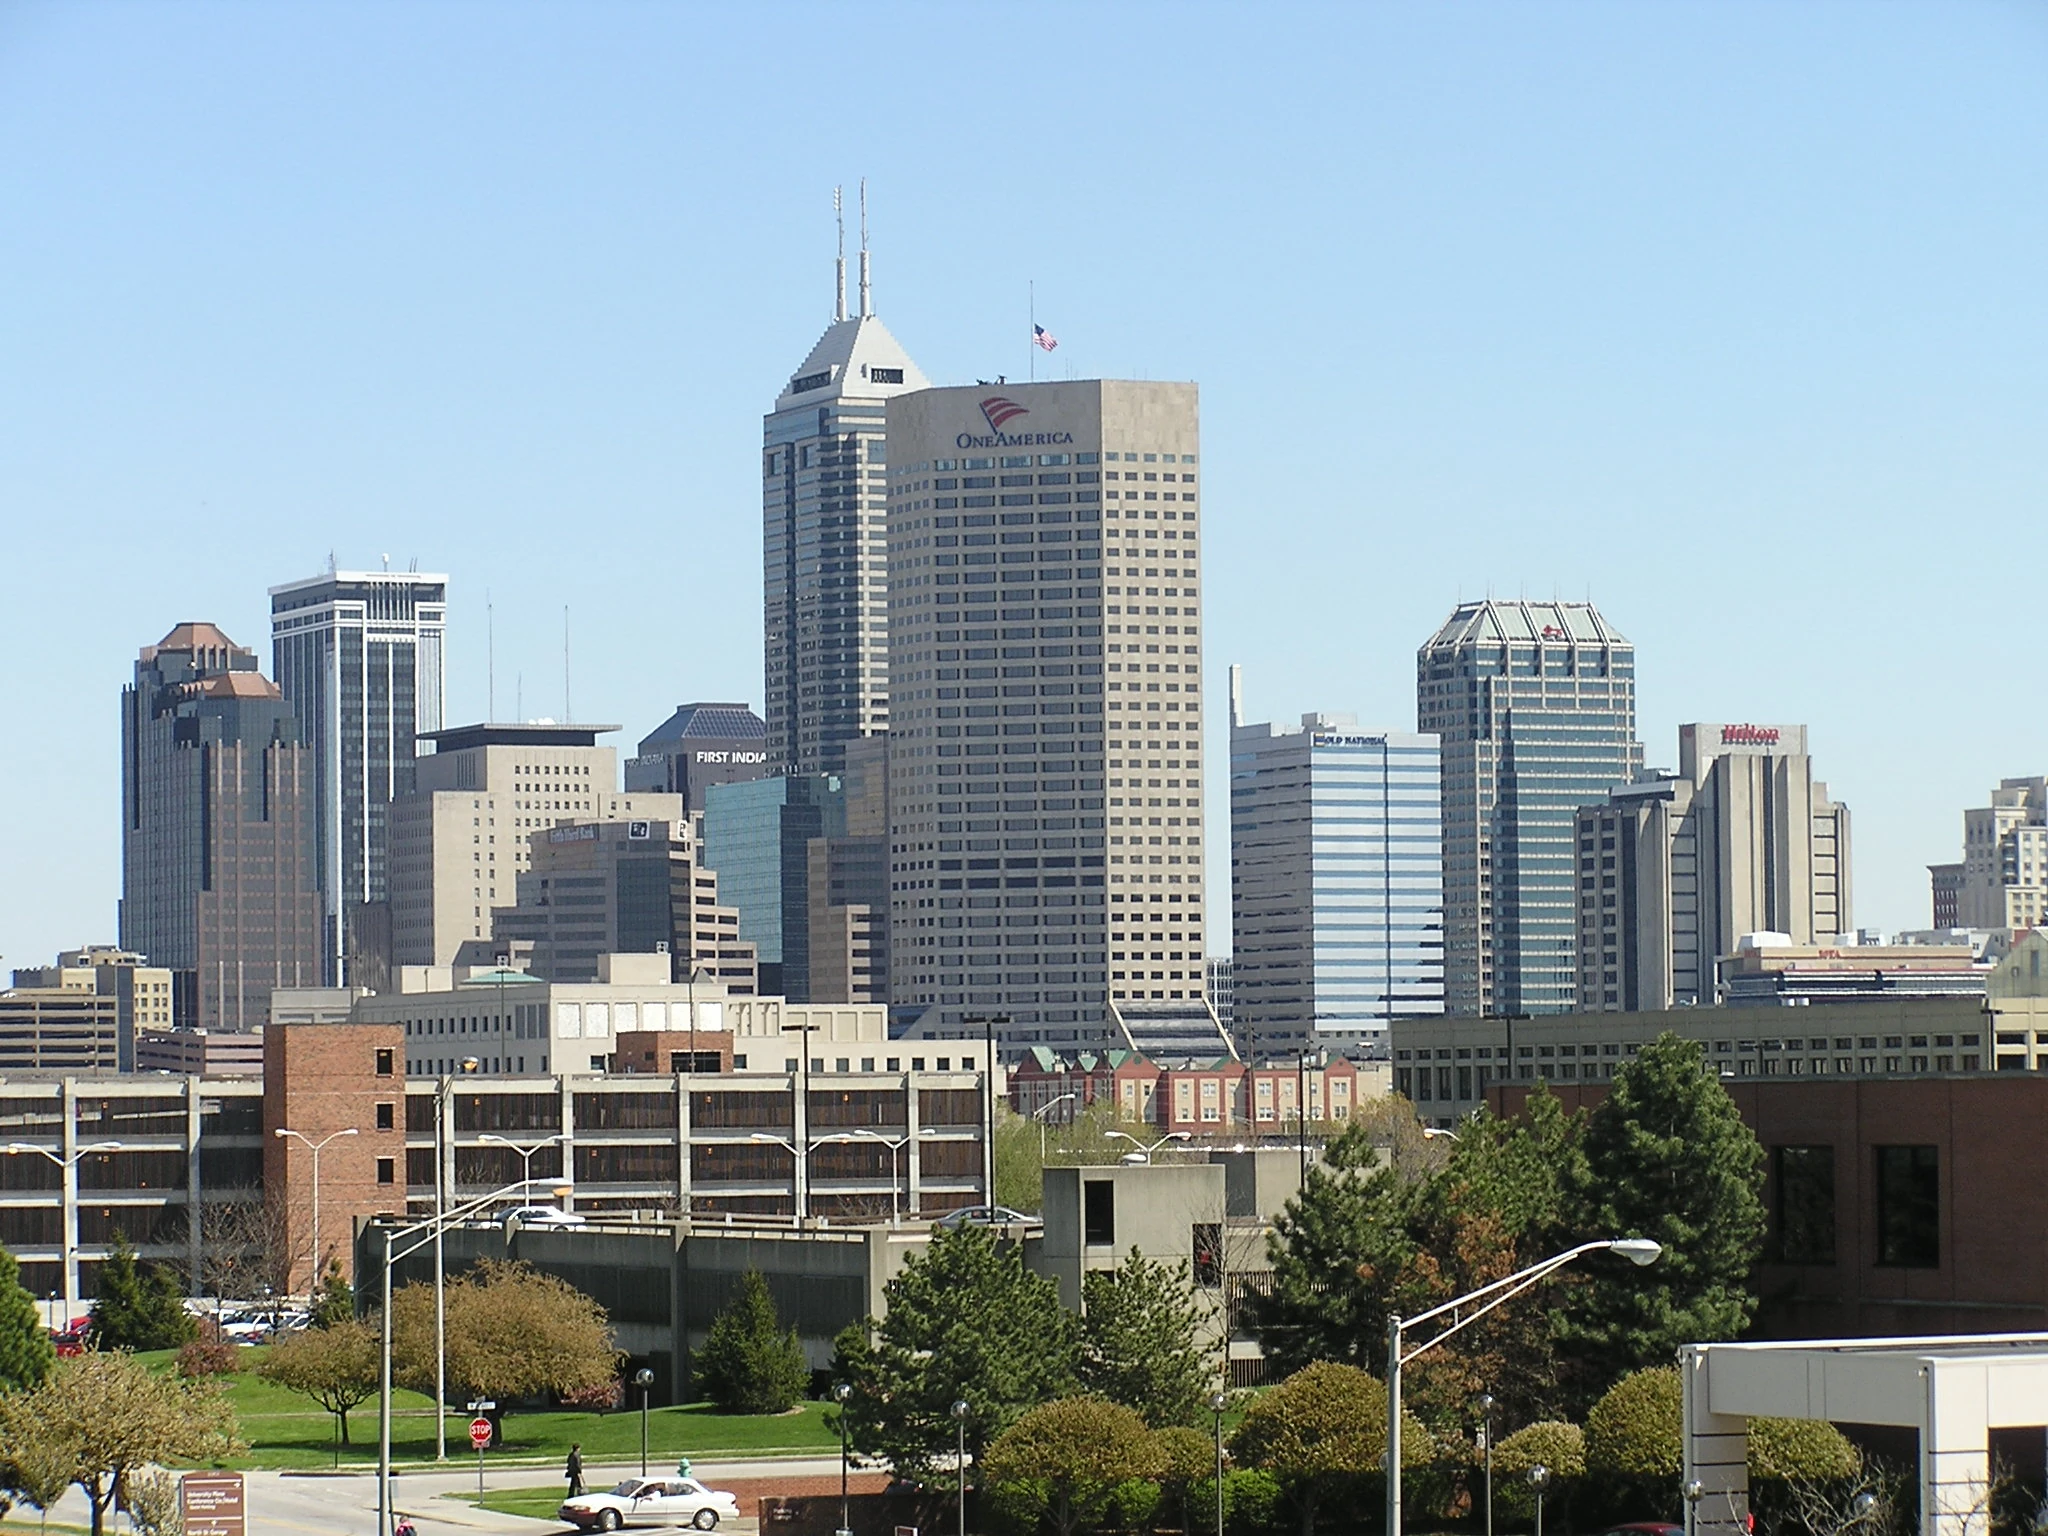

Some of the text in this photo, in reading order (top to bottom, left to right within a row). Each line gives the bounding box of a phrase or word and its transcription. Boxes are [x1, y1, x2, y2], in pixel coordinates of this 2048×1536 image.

[1724, 723, 1780, 742] Hilton
[1325, 736, 1343, 745] OLD
[696, 751, 729, 764] FIRST
[471, 1424, 491, 1435] STOP
